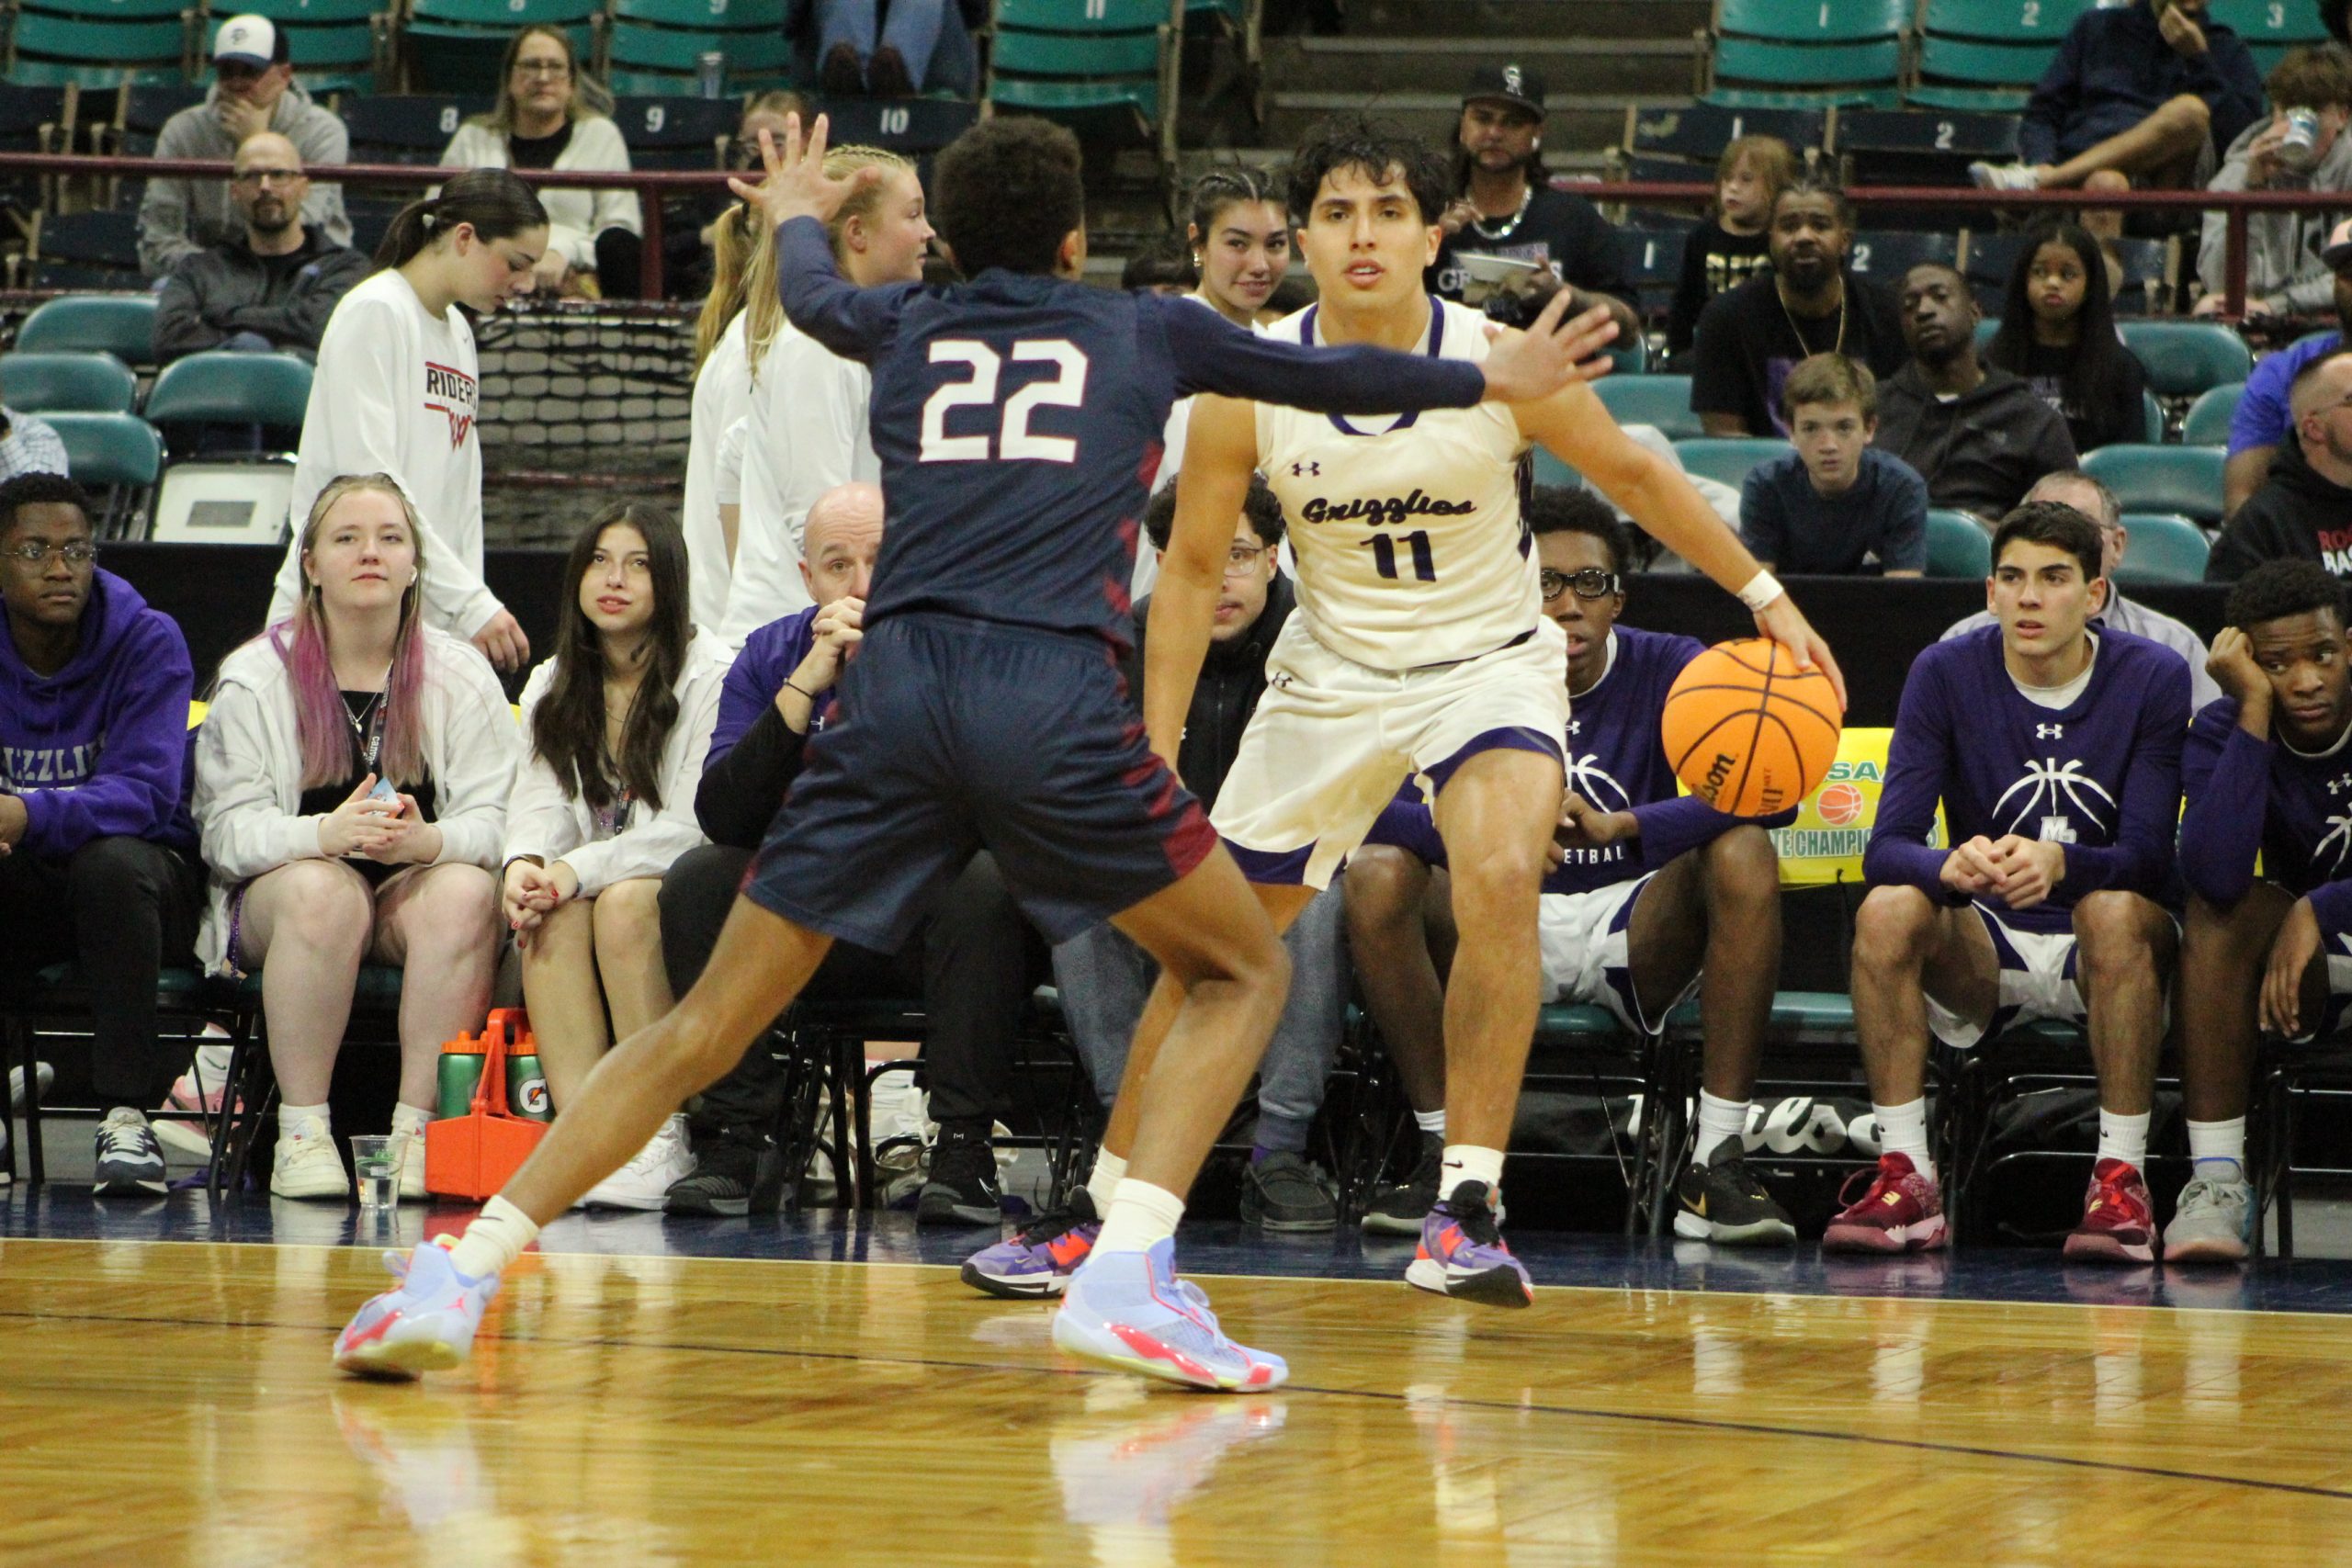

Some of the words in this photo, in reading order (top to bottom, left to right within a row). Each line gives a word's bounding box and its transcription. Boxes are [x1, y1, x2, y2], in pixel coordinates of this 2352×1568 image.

[2021, 2, 2039, 26] 2
[2267, 4, 2283, 28] 3
[439, 107, 458, 133] 8
[645, 107, 665, 132] 9
[880, 108, 909, 134] 10
[1935, 121, 1954, 149] 2
[1851, 243, 1871, 271] 2
[919, 339, 1090, 464] 22
[1301, 488, 1477, 526] Grizzlies
[1359, 529, 1437, 582] 11
[519, 1077, 548, 1113] G
